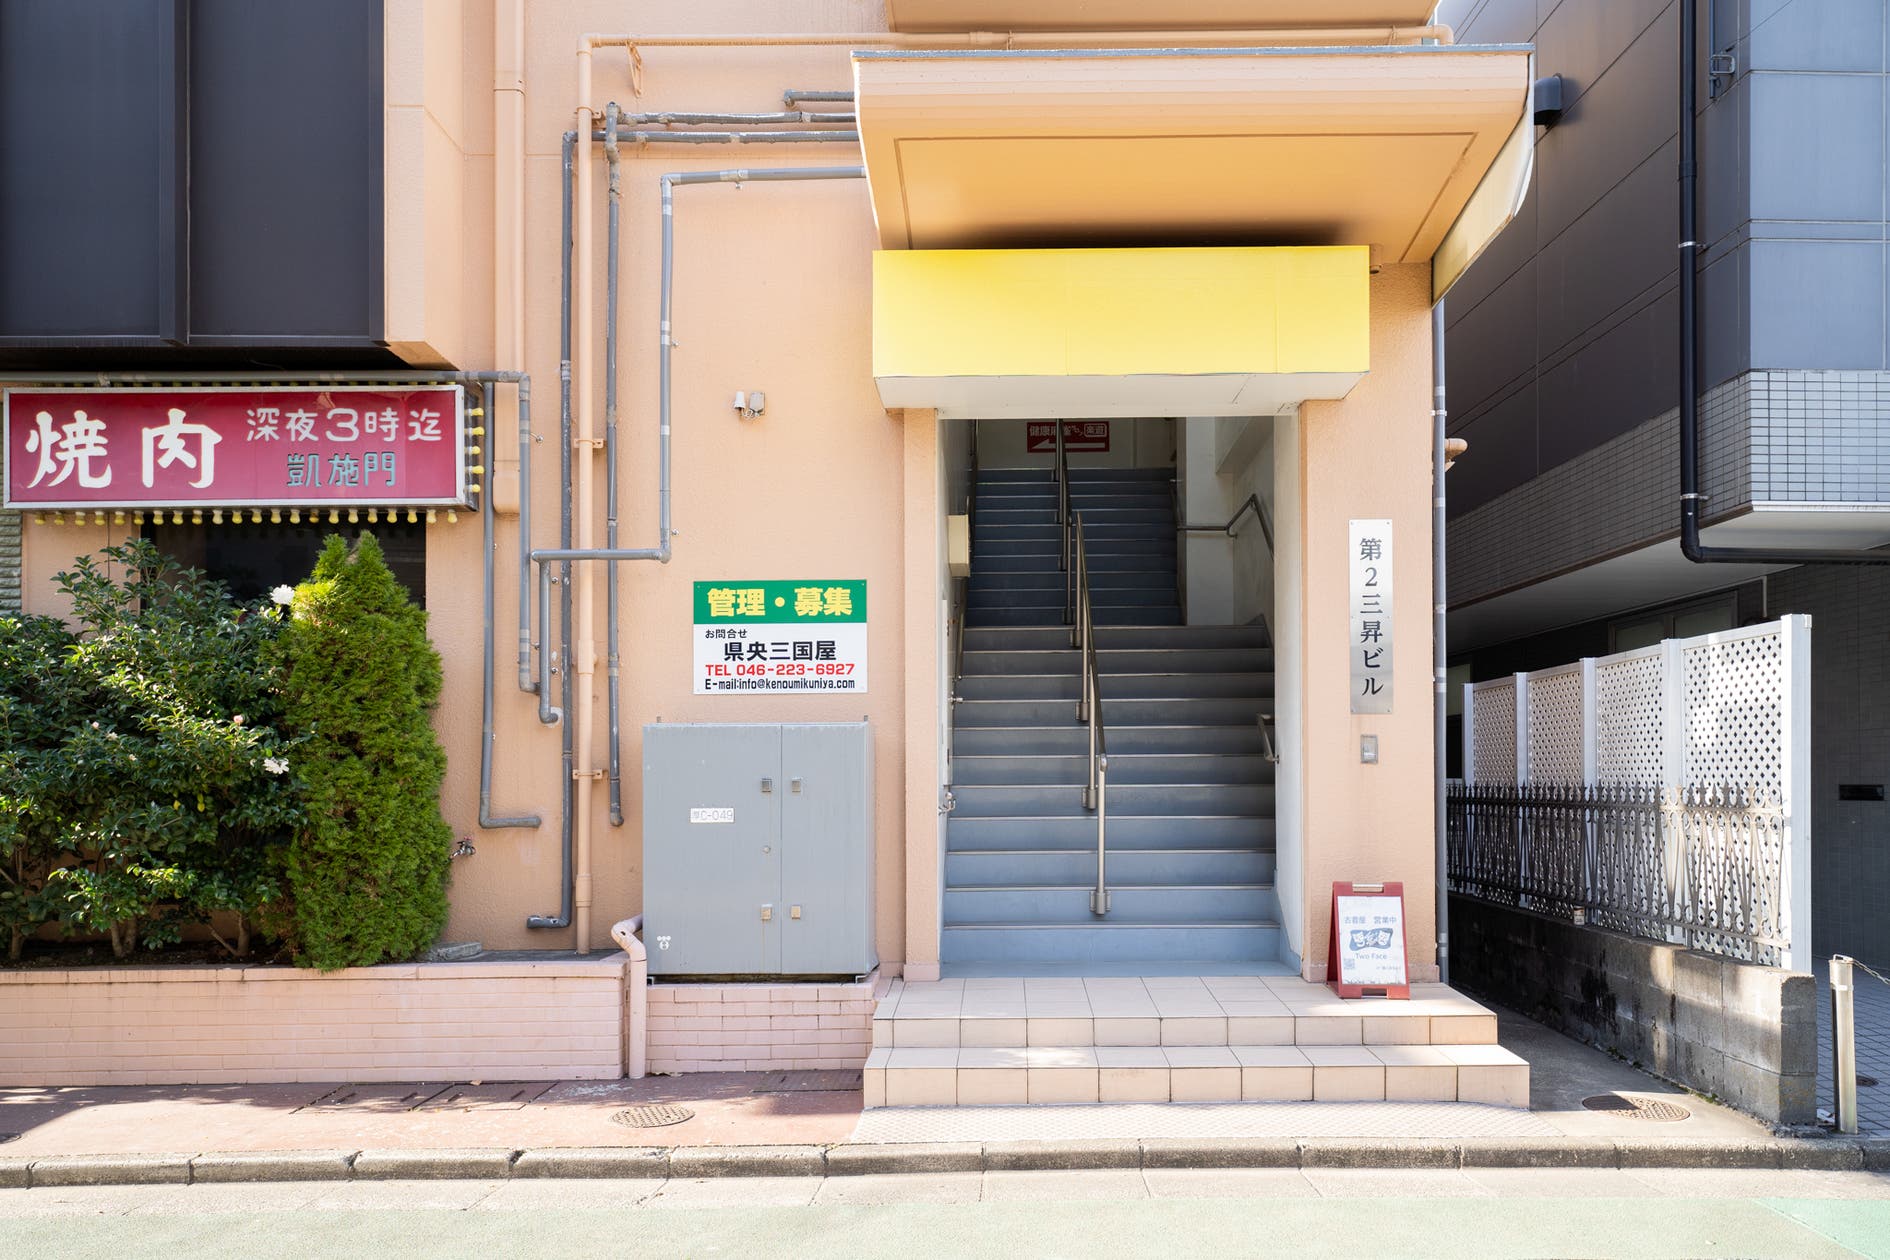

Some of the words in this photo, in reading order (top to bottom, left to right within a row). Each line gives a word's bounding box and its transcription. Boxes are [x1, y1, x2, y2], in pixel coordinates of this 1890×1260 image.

[246, 407, 442, 443] 深夜3時迄
[26, 408, 223, 489] 焼肉
[286, 451, 397, 488] 凱施門
[707, 587, 853, 617] 管理・募集
[1359, 538, 1384, 697] 第2三昇ビル
[705, 628, 748, 639] お問合せ
[724, 640, 837, 662] 県央三国屋
[705, 665, 731, 676] TEL
[736, 663, 855, 676] 046-223-6927
